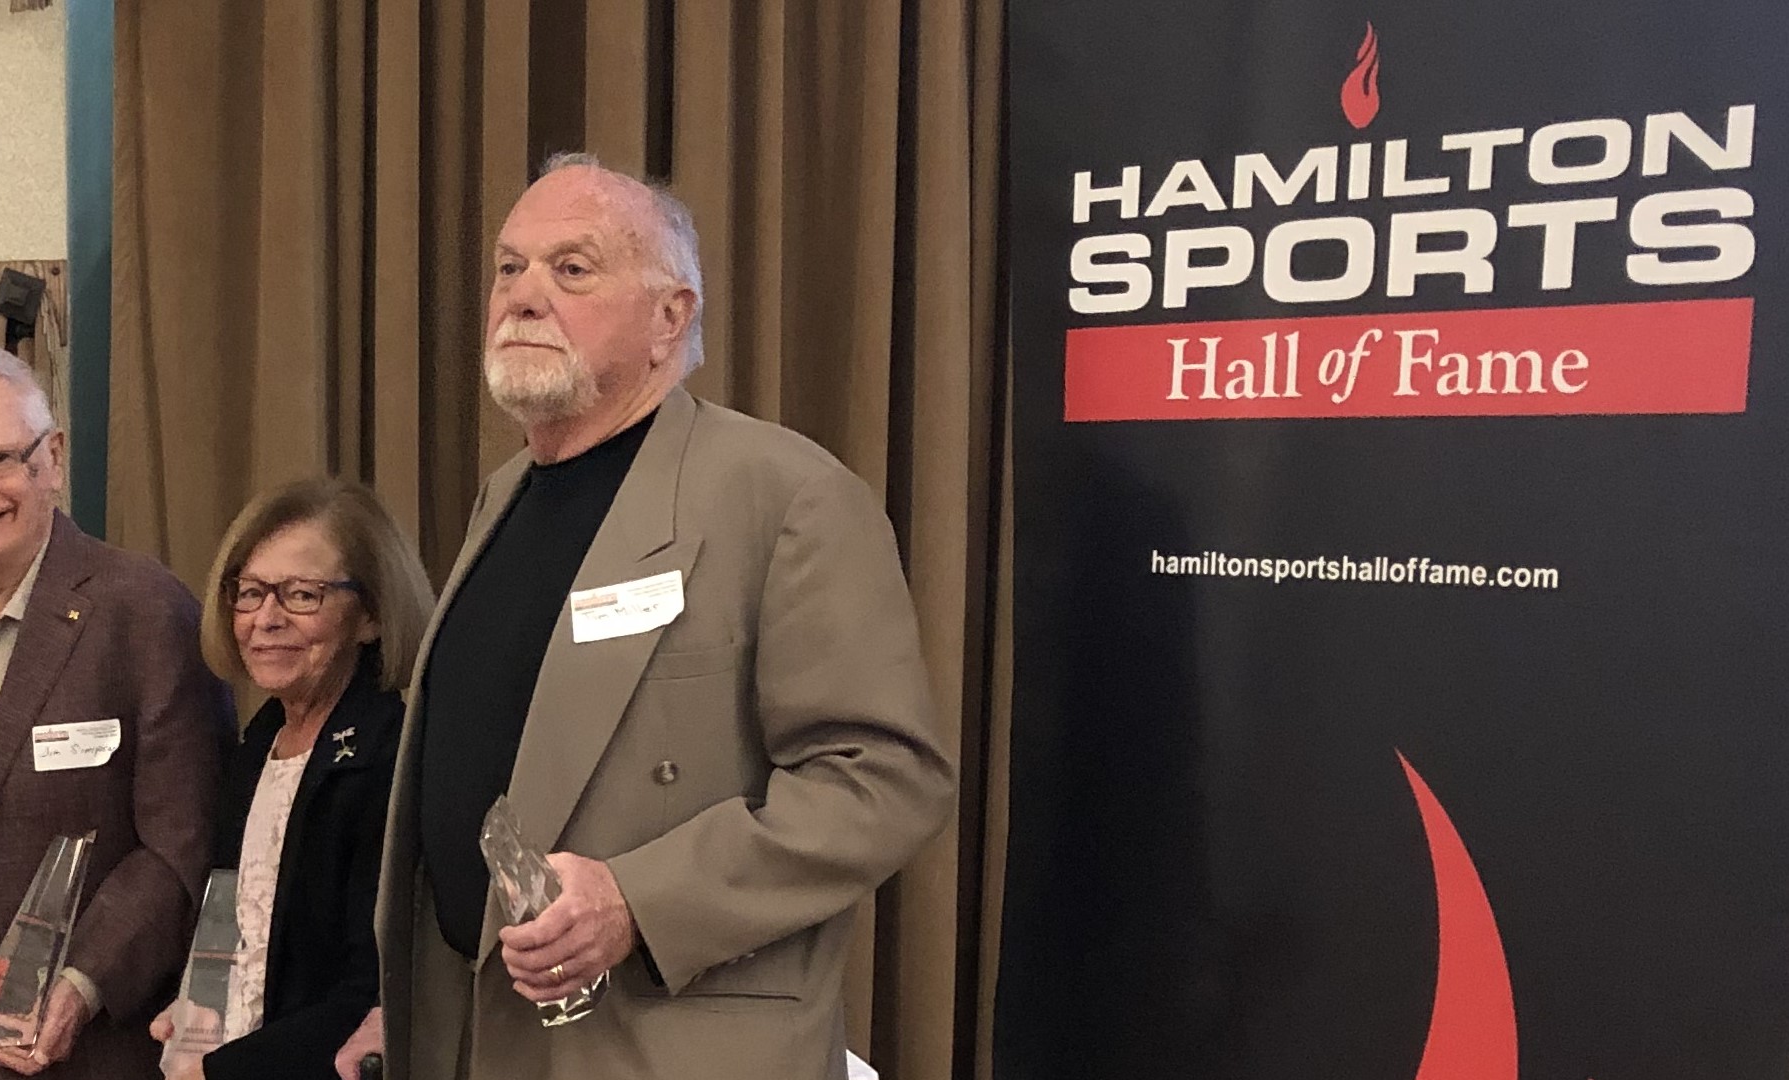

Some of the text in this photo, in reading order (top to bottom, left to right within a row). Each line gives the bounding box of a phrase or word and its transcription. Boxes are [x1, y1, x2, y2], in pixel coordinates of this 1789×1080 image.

[1072, 103, 1756, 224] HAMILTON
[1068, 187, 1756, 314] SPORTS
[1165, 328, 1589, 405] Hall of Fame
[1151, 549, 1559, 589] hamiltonsportshalloffame.com
